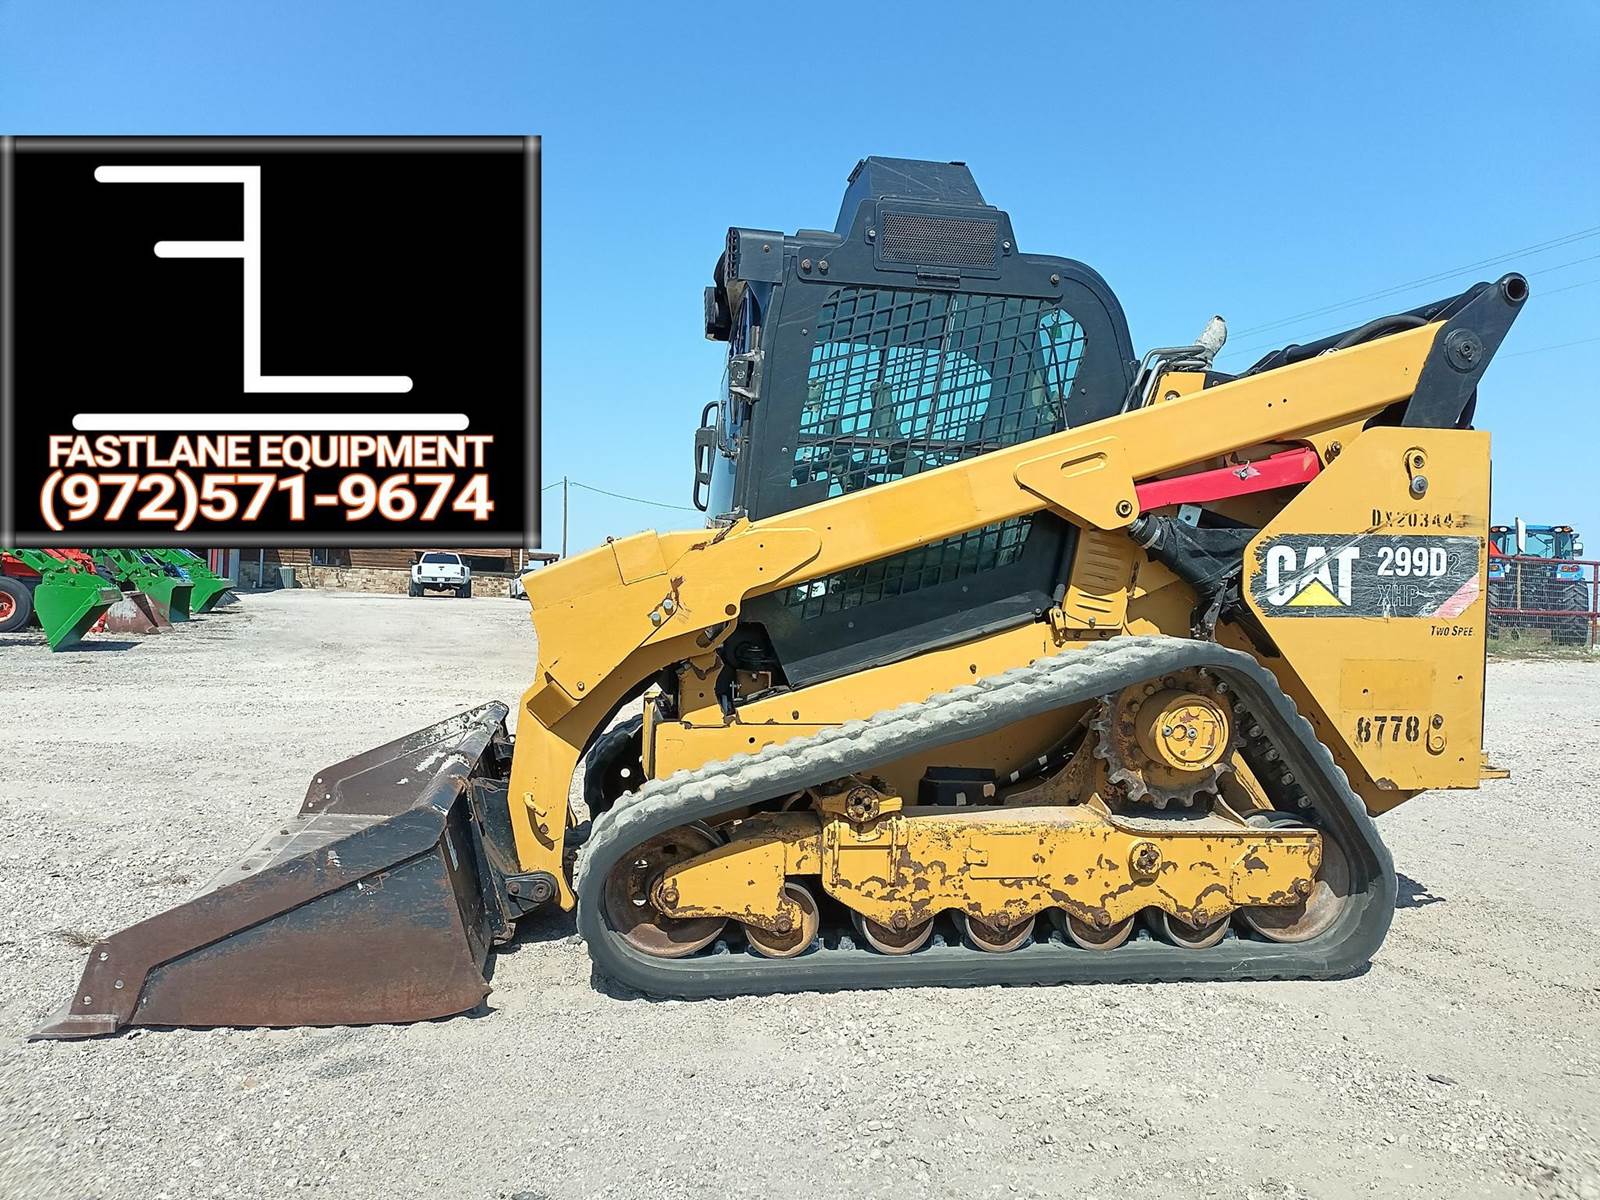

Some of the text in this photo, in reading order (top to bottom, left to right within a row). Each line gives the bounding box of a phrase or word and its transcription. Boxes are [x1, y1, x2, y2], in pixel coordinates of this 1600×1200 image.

[1266, 545, 1360, 606] CAT
[1376, 584, 1420, 607] XHP
[1357, 716, 1420, 742] 8778
